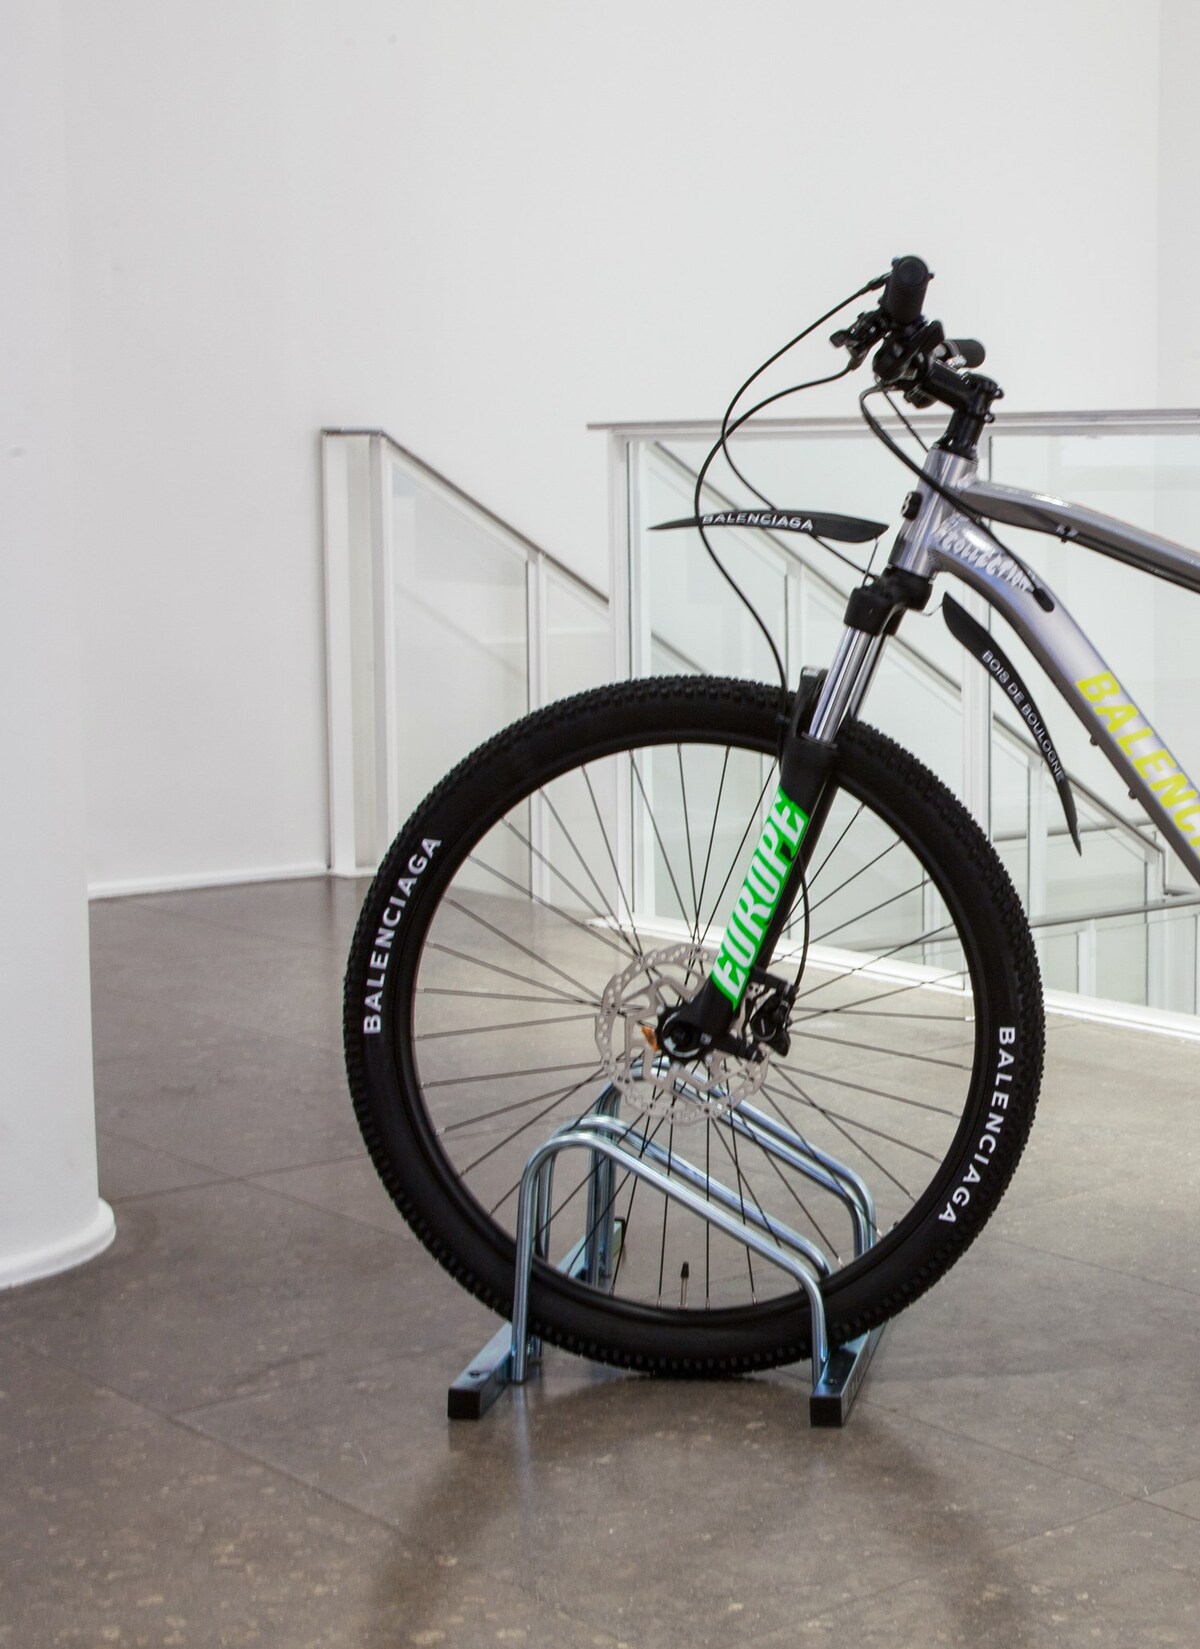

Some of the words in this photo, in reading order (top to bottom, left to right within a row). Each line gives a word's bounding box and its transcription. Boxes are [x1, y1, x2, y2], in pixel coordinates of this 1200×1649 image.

[702, 512, 814, 532] BALENCIAGA
[982, 649, 1008, 684] BOIS
[1006, 679, 1024, 705] DE
[1020, 703, 1066, 782] BOULOGNE
[363, 837, 442, 1034] BALENCIAGA
[711, 786, 808, 1006] EUROPE
[938, 1026, 1016, 1224] BALENCIAGA
